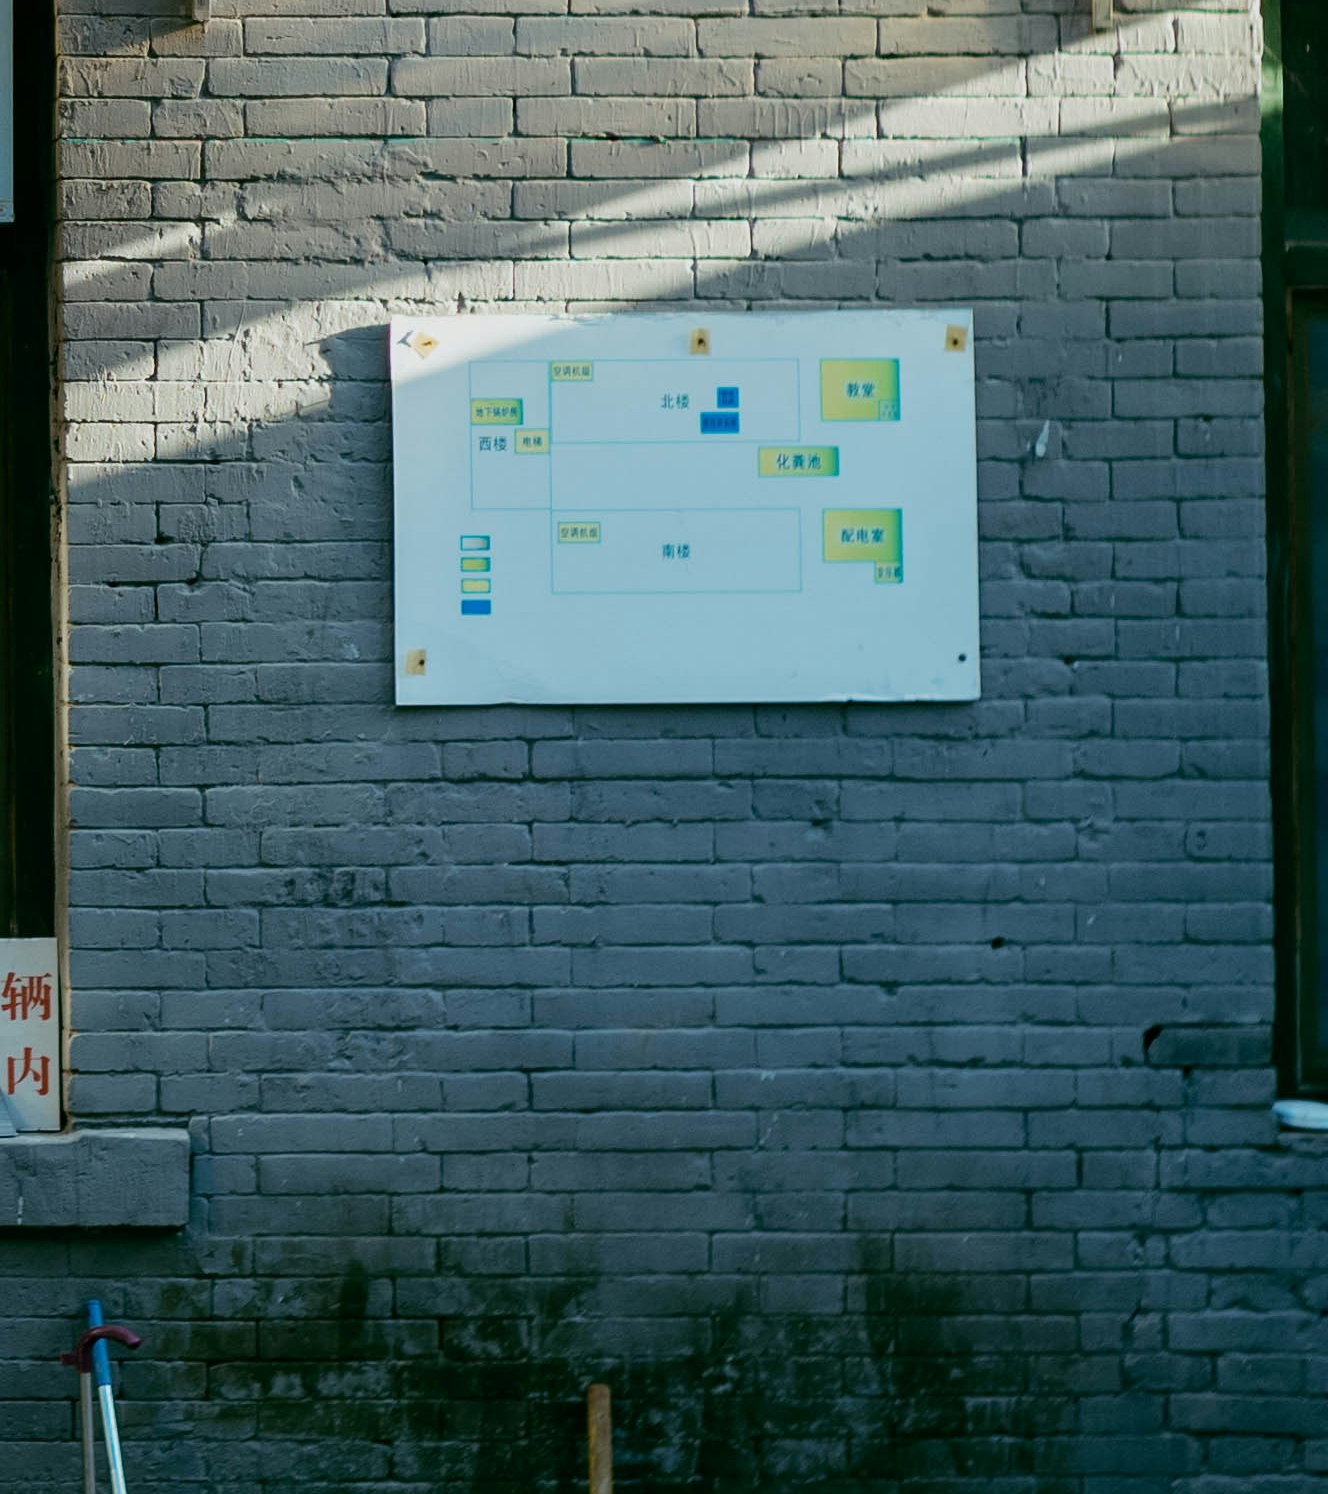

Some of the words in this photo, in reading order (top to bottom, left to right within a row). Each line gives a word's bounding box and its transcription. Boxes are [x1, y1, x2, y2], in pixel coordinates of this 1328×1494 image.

[660, 393, 690, 409] 北楼
[479, 435, 507, 452] 西楼
[522, 435, 543, 448] 电梯
[662, 543, 691, 559] 南楼
